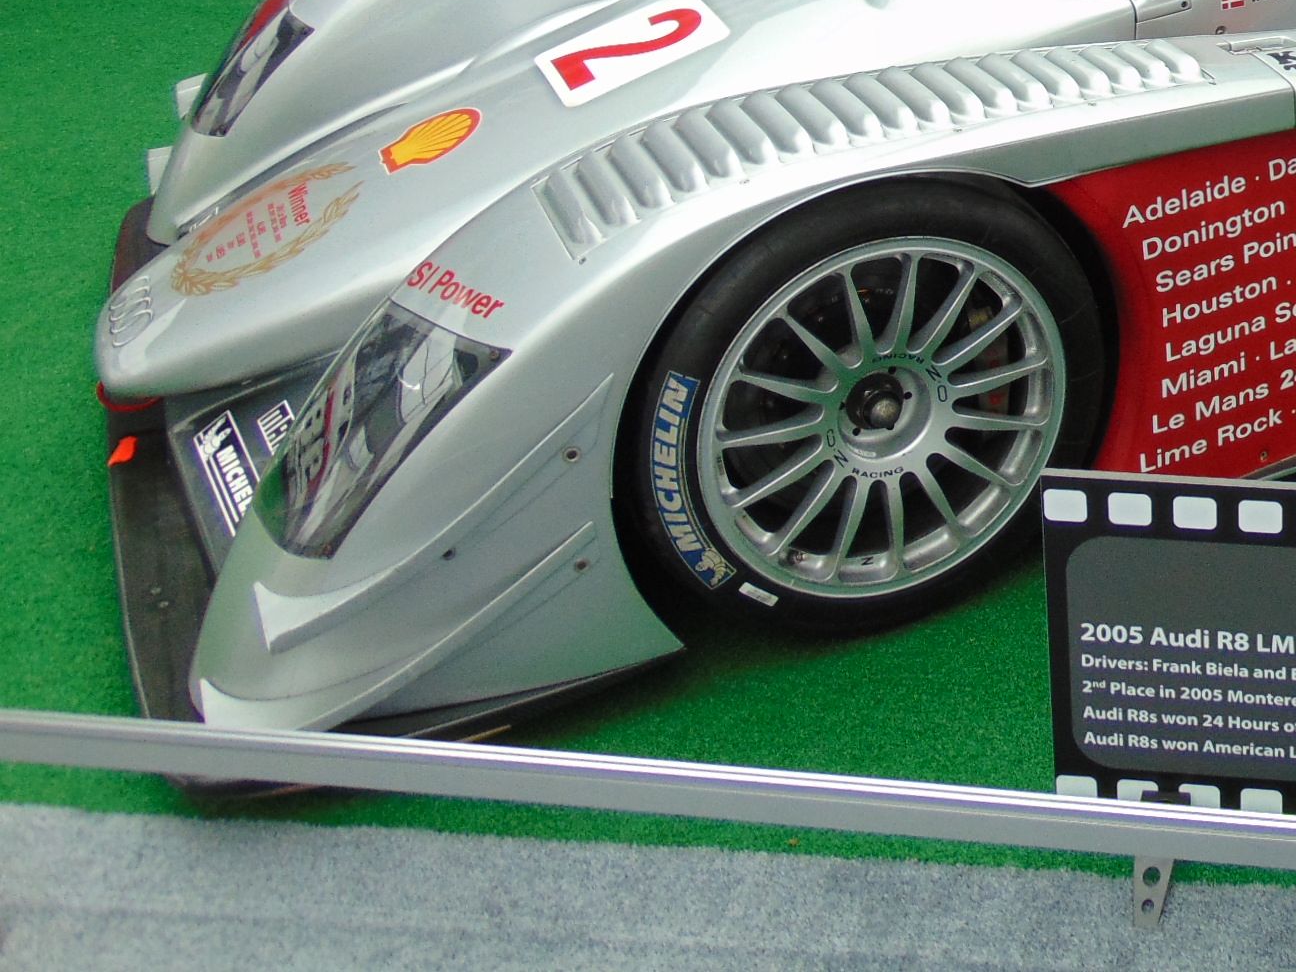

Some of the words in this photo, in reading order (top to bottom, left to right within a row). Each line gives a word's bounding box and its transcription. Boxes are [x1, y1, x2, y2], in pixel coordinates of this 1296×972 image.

[550, 8, 702, 91] 2
[288, 182, 311, 226] Winner
[1122, 175, 1247, 228] Adelaide
[1142, 198, 1286, 261] Donington
[407, 261, 440, 290] SI
[428, 269, 504, 318] Power
[1155, 254, 1235, 293] Sears
[1161, 275, 1277, 328] Houston
[1165, 315, 1266, 362] Laguna
[1161, 353, 1247, 398] Miami
[1152, 411, 1185, 434] Le
[1195, 383, 1269, 421] Mans
[653, 377, 702, 552] MICHELIN
[1139, 438, 1207, 474] Lime
[1217, 408, 1283, 447] Rock
[216, 444, 253, 517] MICHEL
[852, 466, 904, 479] RACING
[1080, 623, 1143, 645] 2005
[1150, 627, 1210, 649] Audi
[1217, 631, 1250, 652] R8
[1081, 653, 1149, 671] Drivers:
[1152, 659, 1202, 675] Frank
[1205, 662, 1249, 678] Biela
[1253, 666, 1286, 680] and
[1082, 679, 1106, 693] 2nd
[1110, 681, 1155, 697] Place
[1159, 685, 1176, 699] in
[1180, 687, 1223, 702] 2005
[1083, 706, 1123, 721] Audi
[1127, 708, 1158, 723] R8s
[1162, 714, 1198, 726] won
[1202, 714, 1224, 728] 24
[1228, 716, 1279, 732] Hours
[1084, 731, 1124, 746] Audi
[1128, 734, 1158, 749] R8s
[1162, 740, 1198, 752] won
[1203, 740, 1285, 758] American
